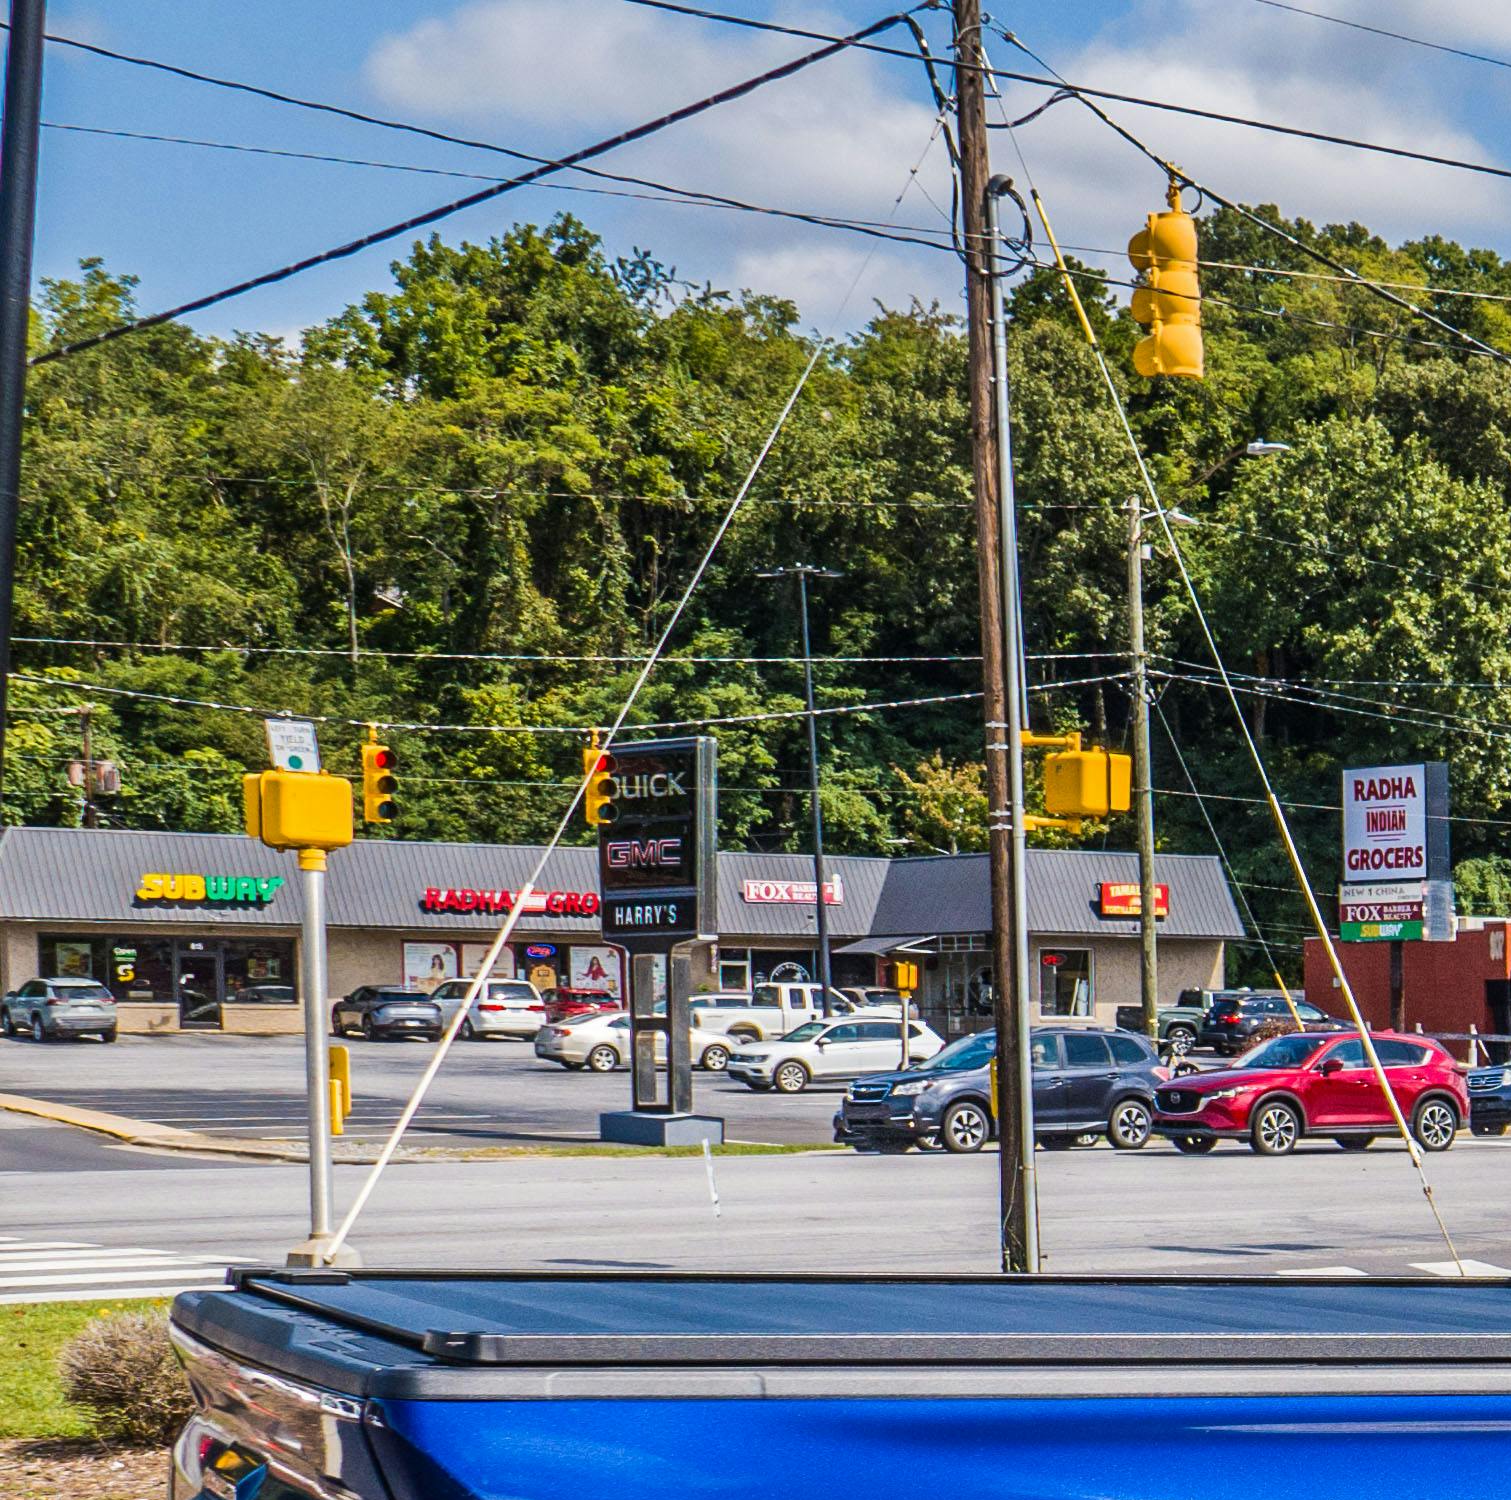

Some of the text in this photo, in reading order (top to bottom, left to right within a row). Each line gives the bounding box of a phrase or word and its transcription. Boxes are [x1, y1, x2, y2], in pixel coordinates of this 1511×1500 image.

[1353, 776, 1417, 801] RADHA
[1365, 809, 1406, 832] INDIAN
[607, 838, 681, 868] GMC
[1347, 846, 1424, 871] GROCERS
[136, 872, 285, 901] SUBWAY
[747, 883, 792, 900] FOX
[1343, 888, 1365, 897] NEW
[1375, 886, 1406, 895] CHINA
[425, 887, 513, 911] RADHA
[545, 891, 600, 914] GRO
[615, 904, 677, 926] HARRY'S
[1346, 905, 1382, 921] FOX
[1360, 923, 1403, 937] SUBWAY
